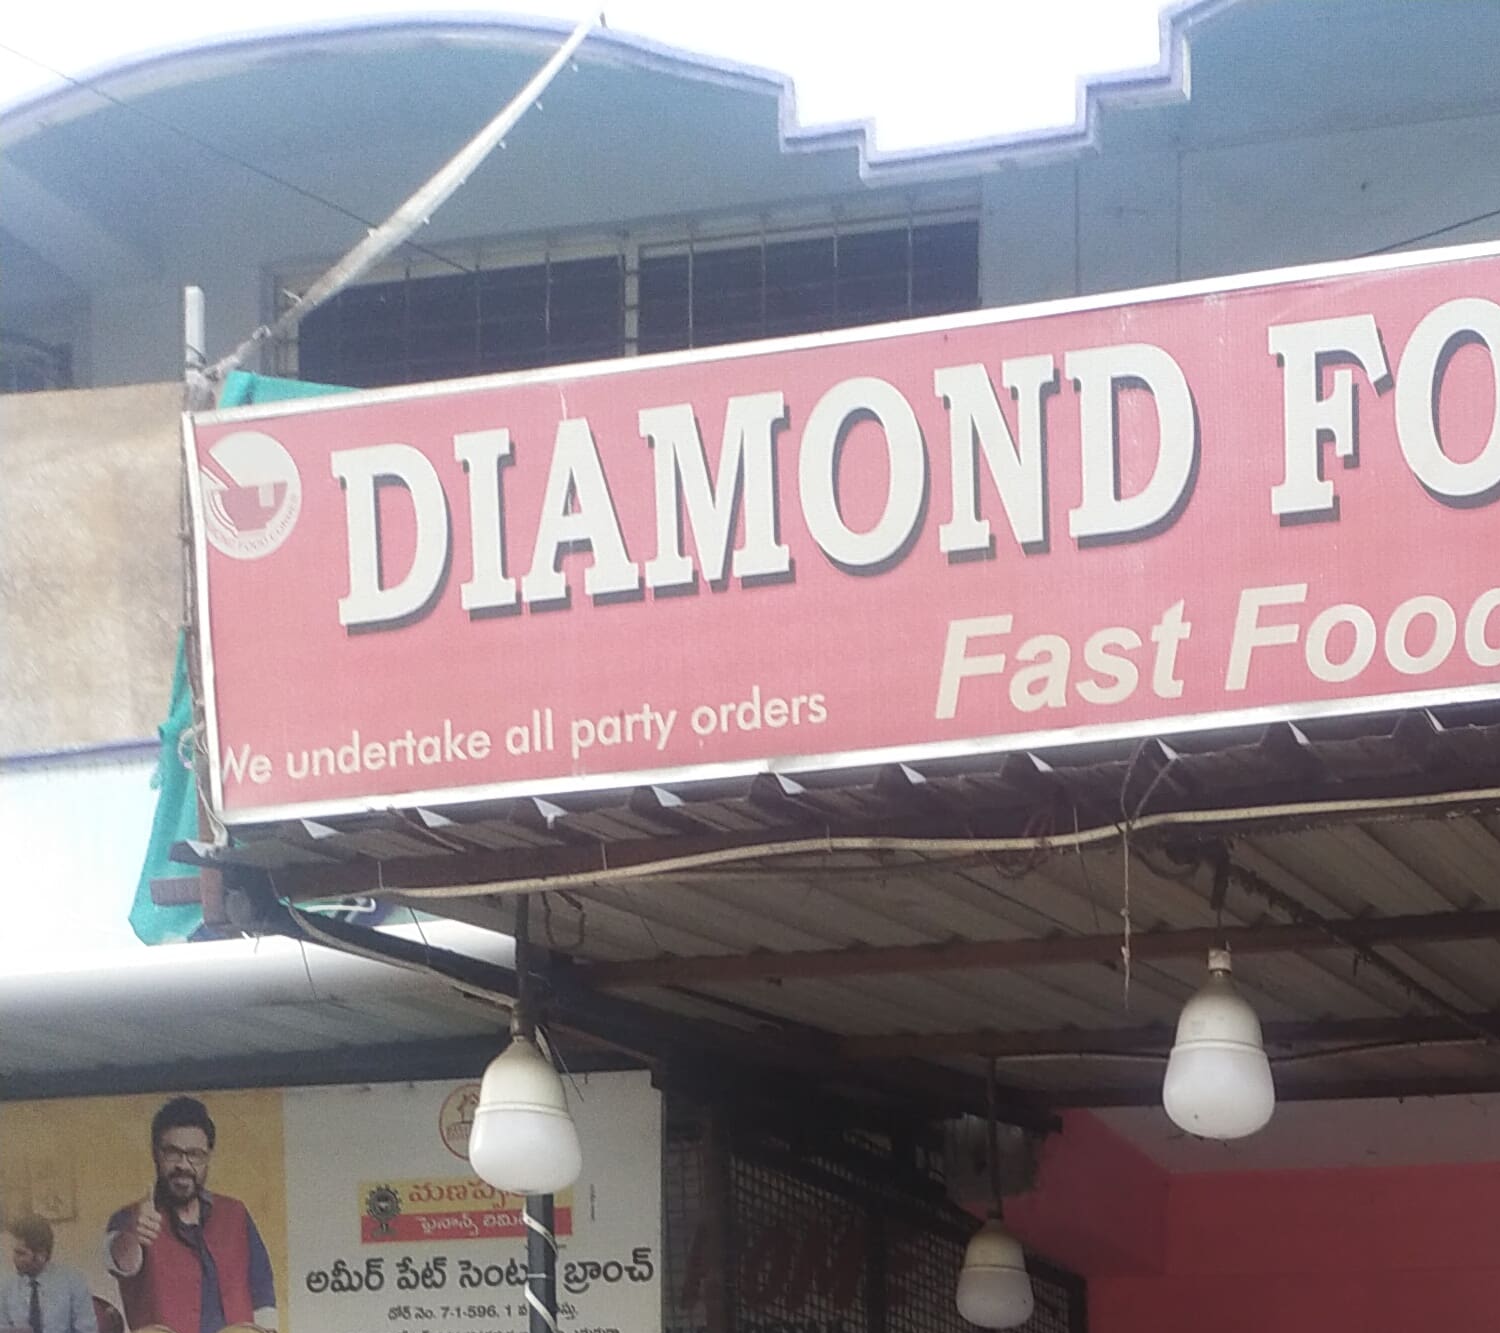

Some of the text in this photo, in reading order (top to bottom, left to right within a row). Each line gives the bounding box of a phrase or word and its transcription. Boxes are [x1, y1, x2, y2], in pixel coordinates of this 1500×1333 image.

[331, 343, 1197, 630] DIAMOND
[935, 599, 1190, 719] Fast
[286, 720, 491, 780] undertake
[504, 706, 554, 755] all
[570, 698, 676, 758] party
[697, 684, 828, 734] orders
[306, 1246, 655, 1294] అమీర్ పేట్ సెంట బ్రాంచ్
